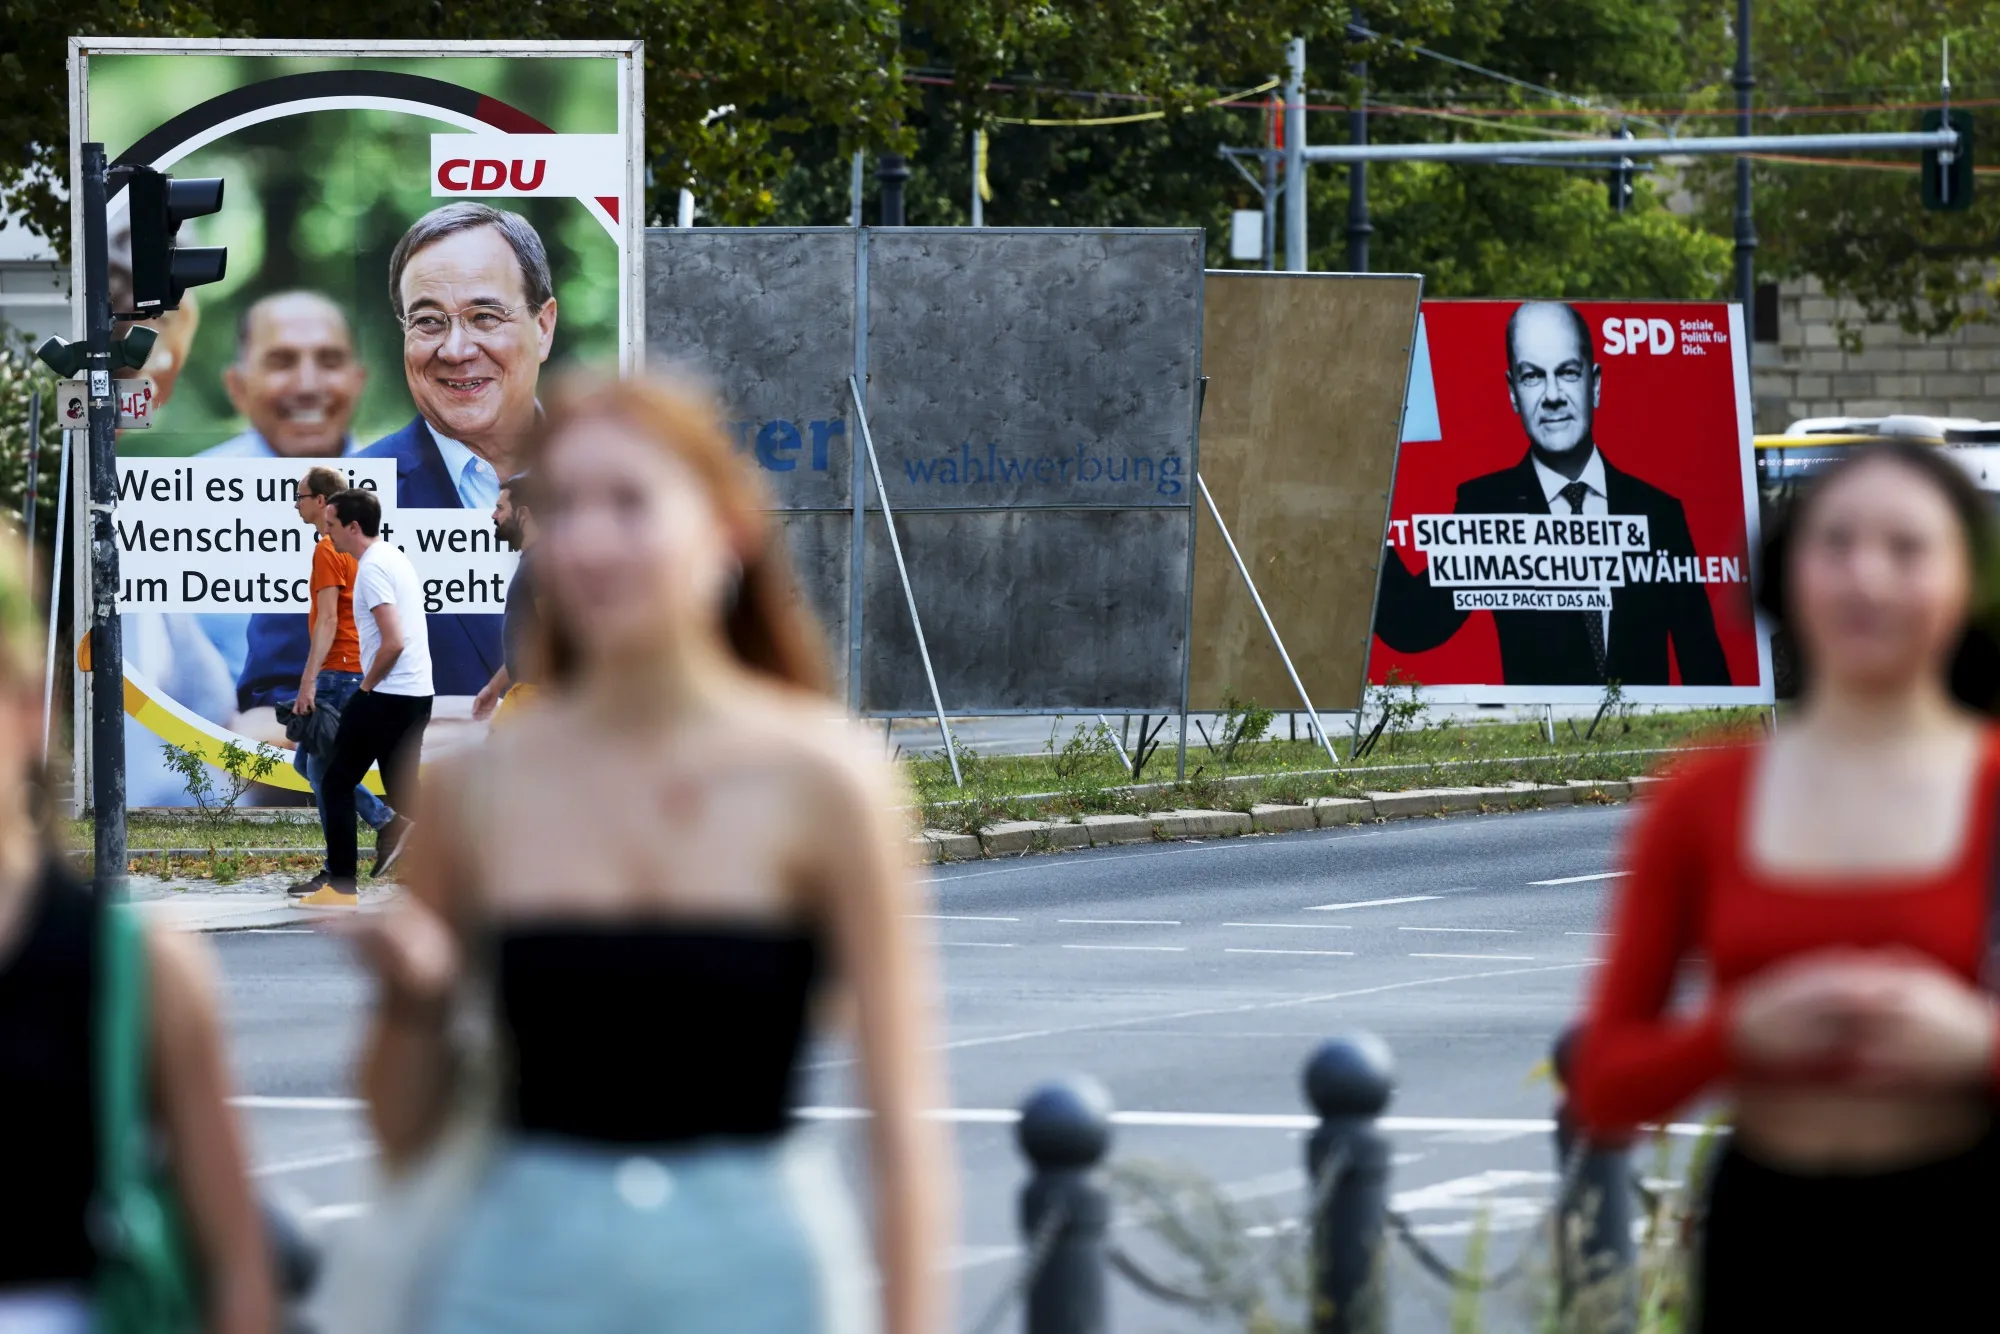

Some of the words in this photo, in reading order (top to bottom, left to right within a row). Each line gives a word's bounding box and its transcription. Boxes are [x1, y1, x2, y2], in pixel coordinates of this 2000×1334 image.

[437, 158, 546, 191] CDU
[1602, 317, 1675, 355] SPD
[1680, 319, 1714, 331] Soziale
[1681, 332, 1711, 343] Politik
[1713, 331, 1728, 343] für
[1682, 344, 1707, 355] Dich.
[116, 467, 193, 502] Weil
[206, 477, 244, 502] es
[904, 443, 1183, 495] wahlwerbung
[118, 518, 301, 552] Menschen
[1417, 519, 1527, 546] SICHERE
[1534, 519, 1622, 546] ARBEIT
[1627, 522, 1645, 546] &
[1433, 554, 1620, 582] KLIMASCHUTZ
[1625, 549, 1748, 583] WÄHLEN.
[182, 570, 310, 603] Deutsc
[423, 568, 506, 613] geht
[1456, 592, 1509, 608] SCHOLZ
[1513, 592, 1553, 608] PACKT
[1557, 593, 1583, 608] DAS
[1587, 593, 1610, 608] AN.
